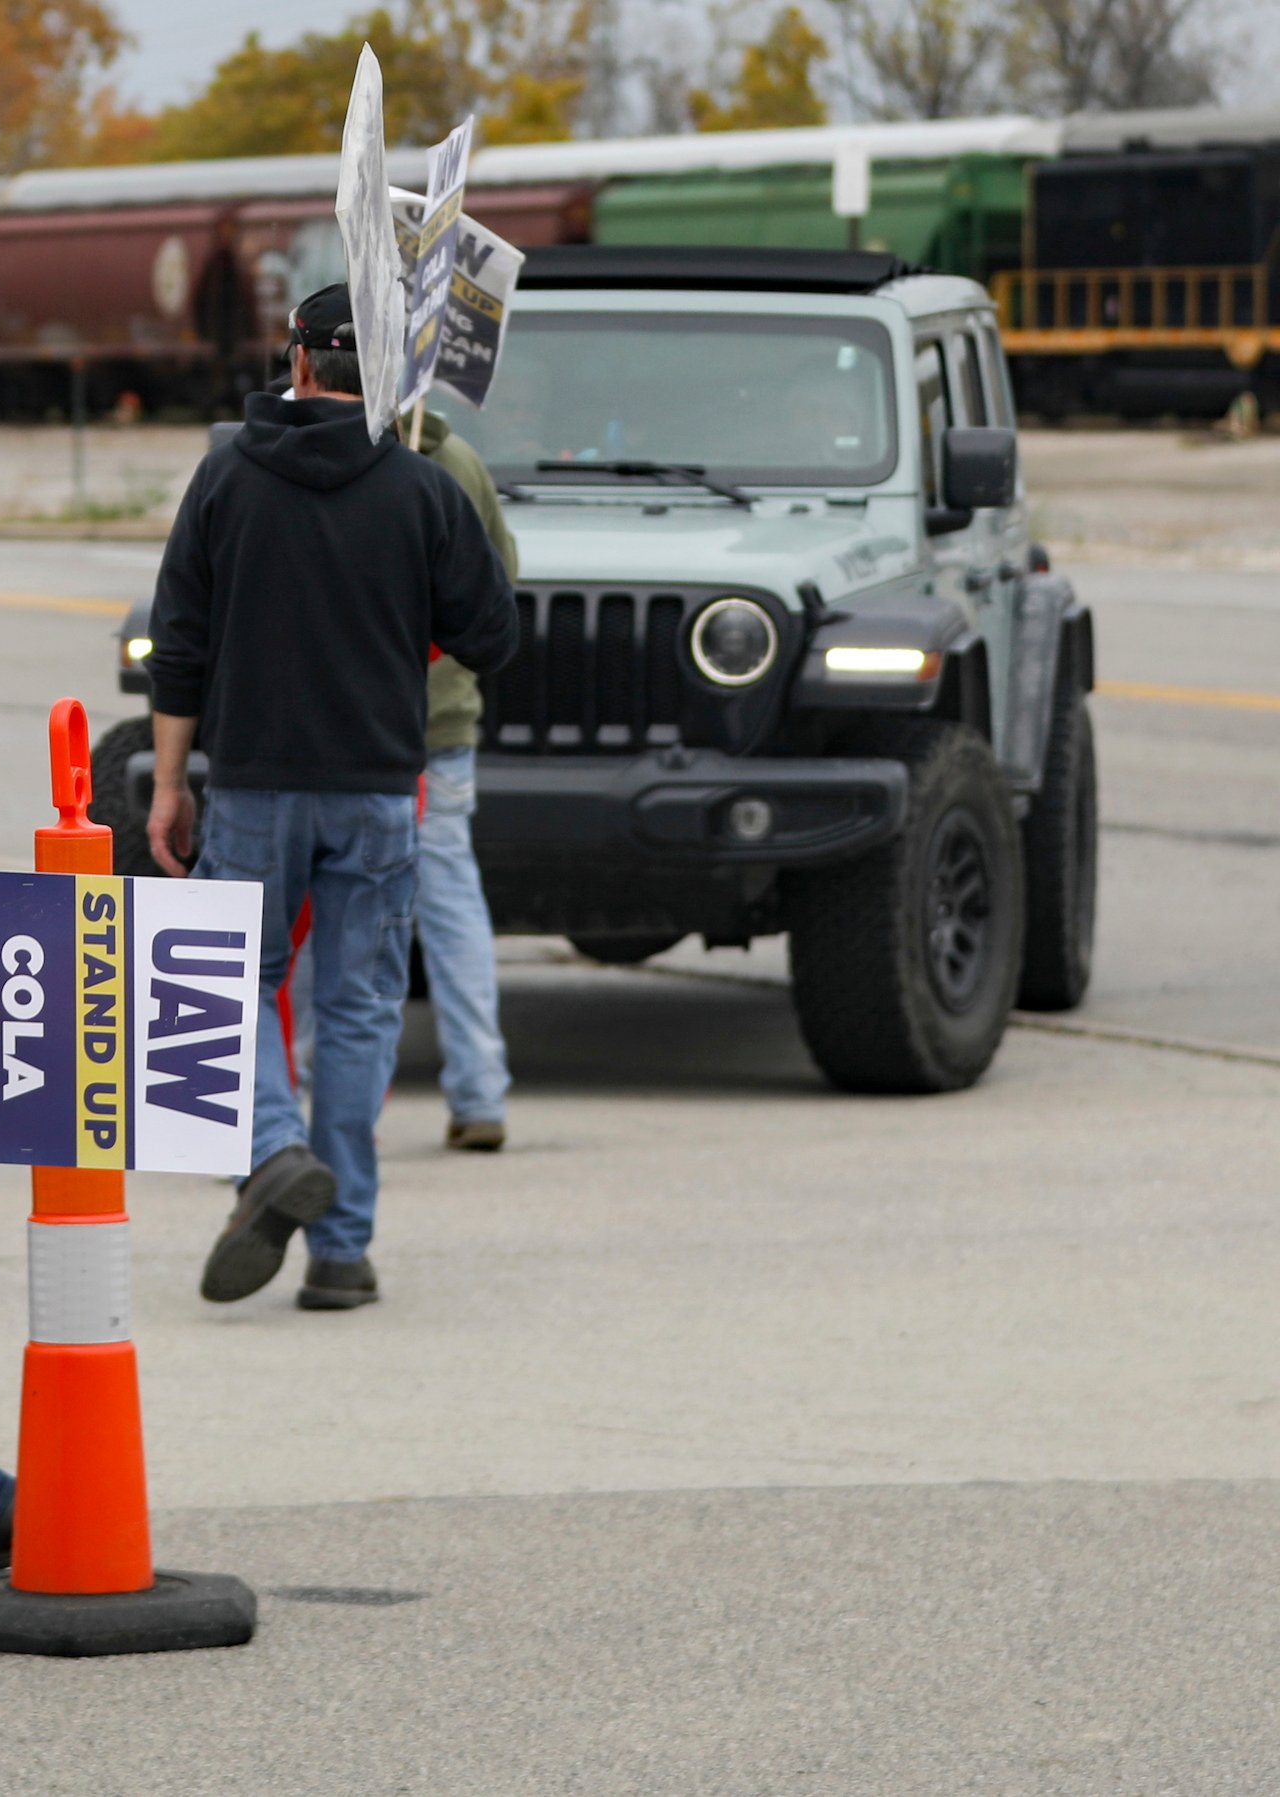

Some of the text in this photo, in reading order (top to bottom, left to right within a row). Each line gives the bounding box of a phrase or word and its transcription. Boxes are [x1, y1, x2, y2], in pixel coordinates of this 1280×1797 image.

[1, 934, 45, 1102] COLA
[82, 891, 118, 1151] STAND UP
[145, 928, 247, 1128] UAW
